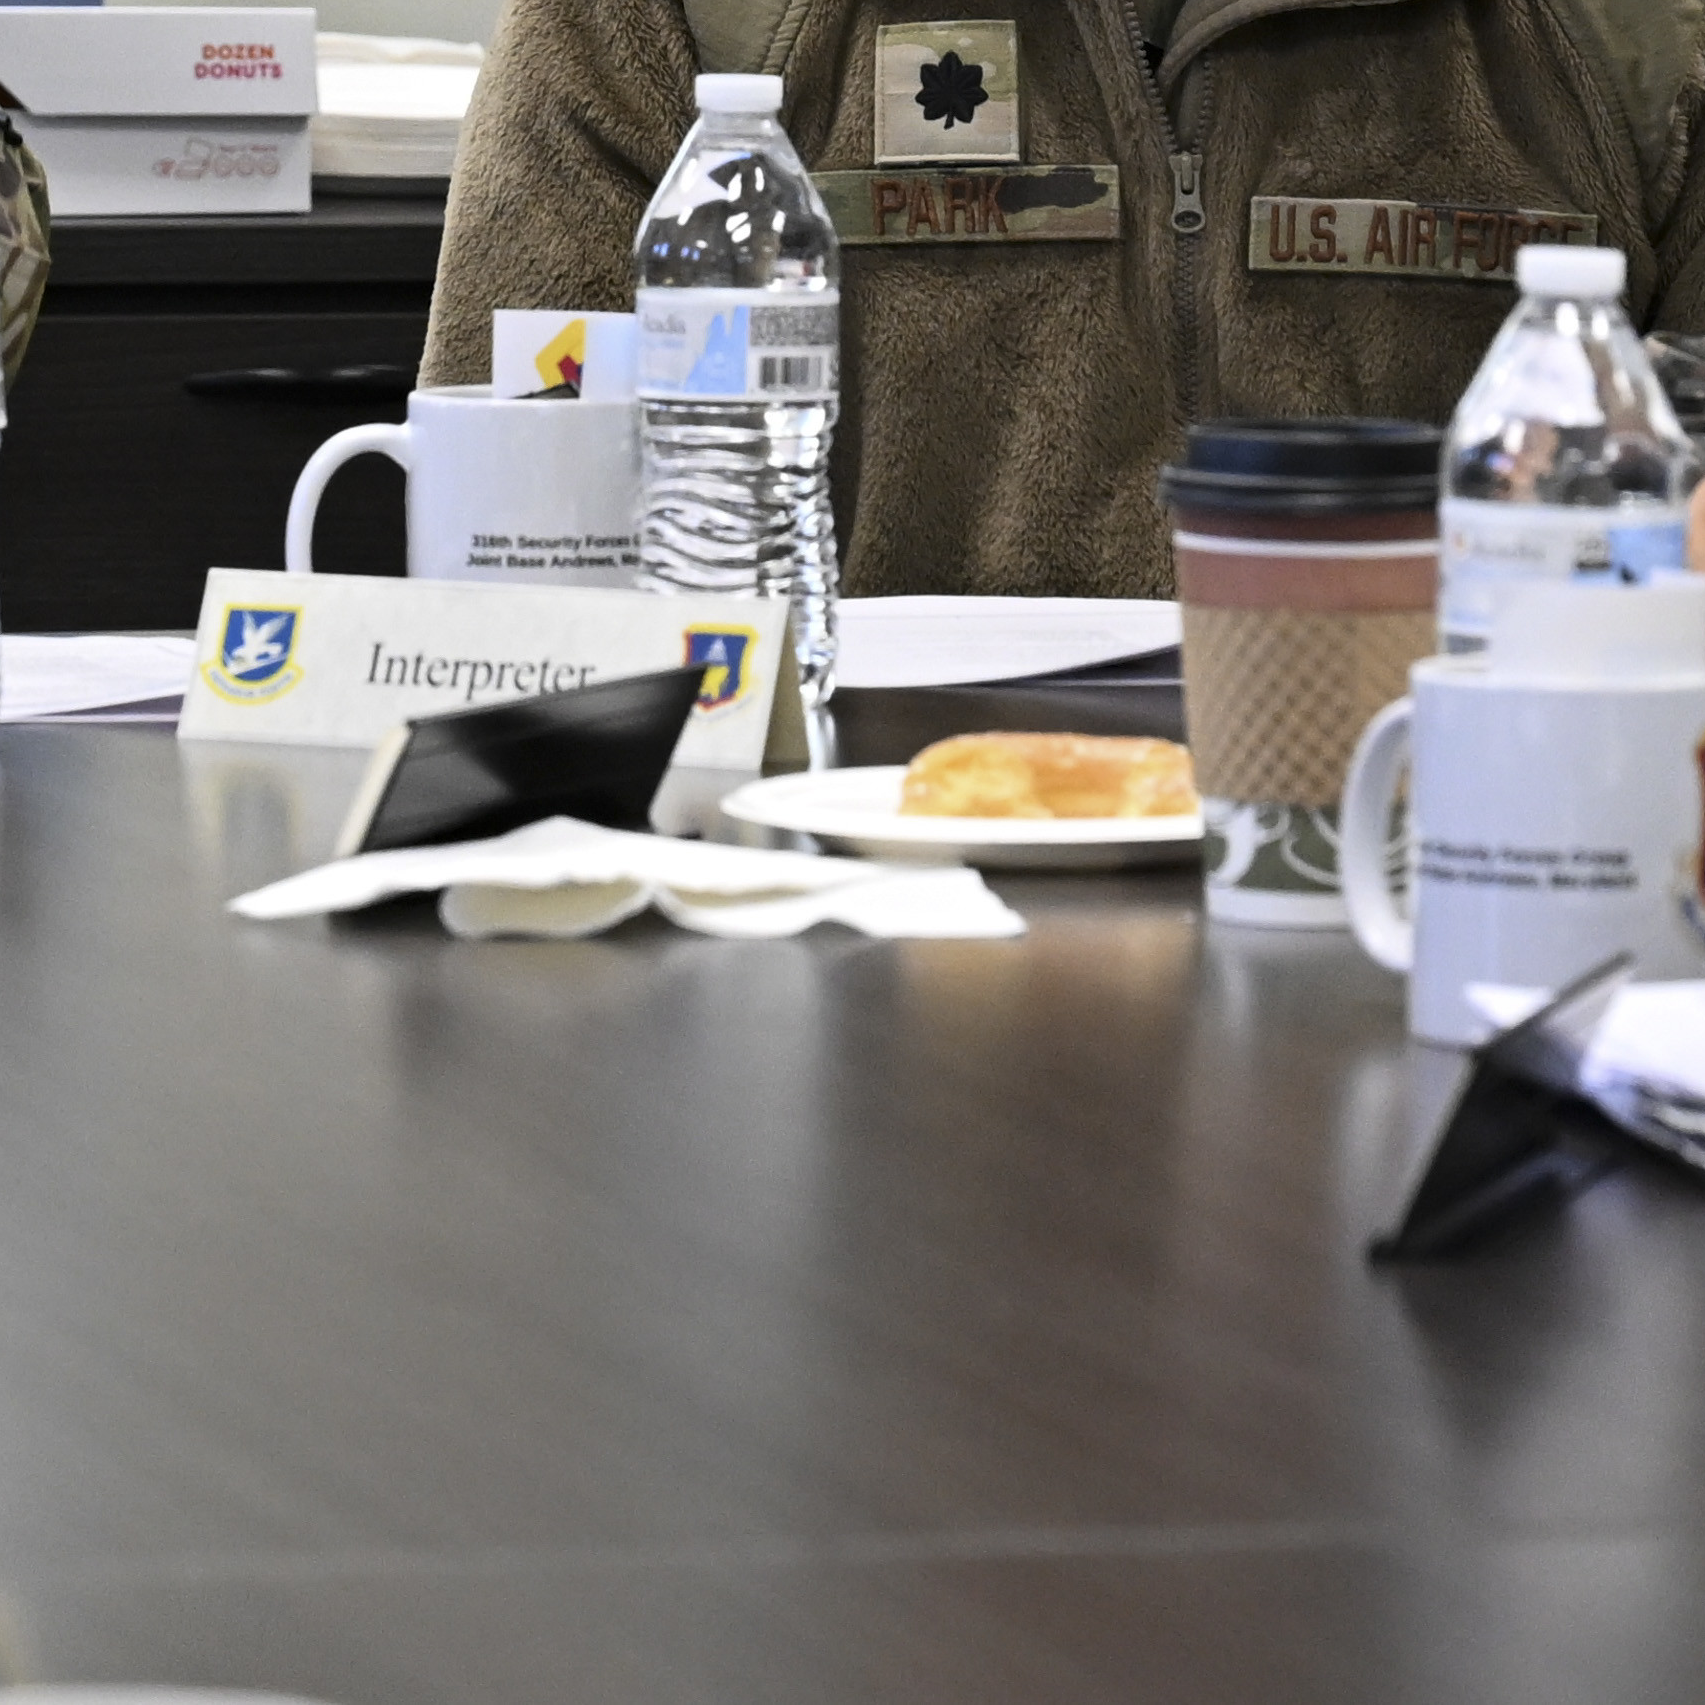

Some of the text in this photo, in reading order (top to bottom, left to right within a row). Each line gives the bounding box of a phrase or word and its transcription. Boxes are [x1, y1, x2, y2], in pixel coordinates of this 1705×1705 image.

[202, 42, 275, 61] DOZEN
[195, 62, 284, 80] DONUTS
[870, 176, 1009, 236] PARK
[1268, 202, 1349, 263] U.S.
[1363, 205, 1439, 268] AIR
[517, 533, 583, 552] Security
[466, 553, 503, 569] Joint
[506, 554, 546, 569] Base
[364, 641, 597, 700] Interpreter
